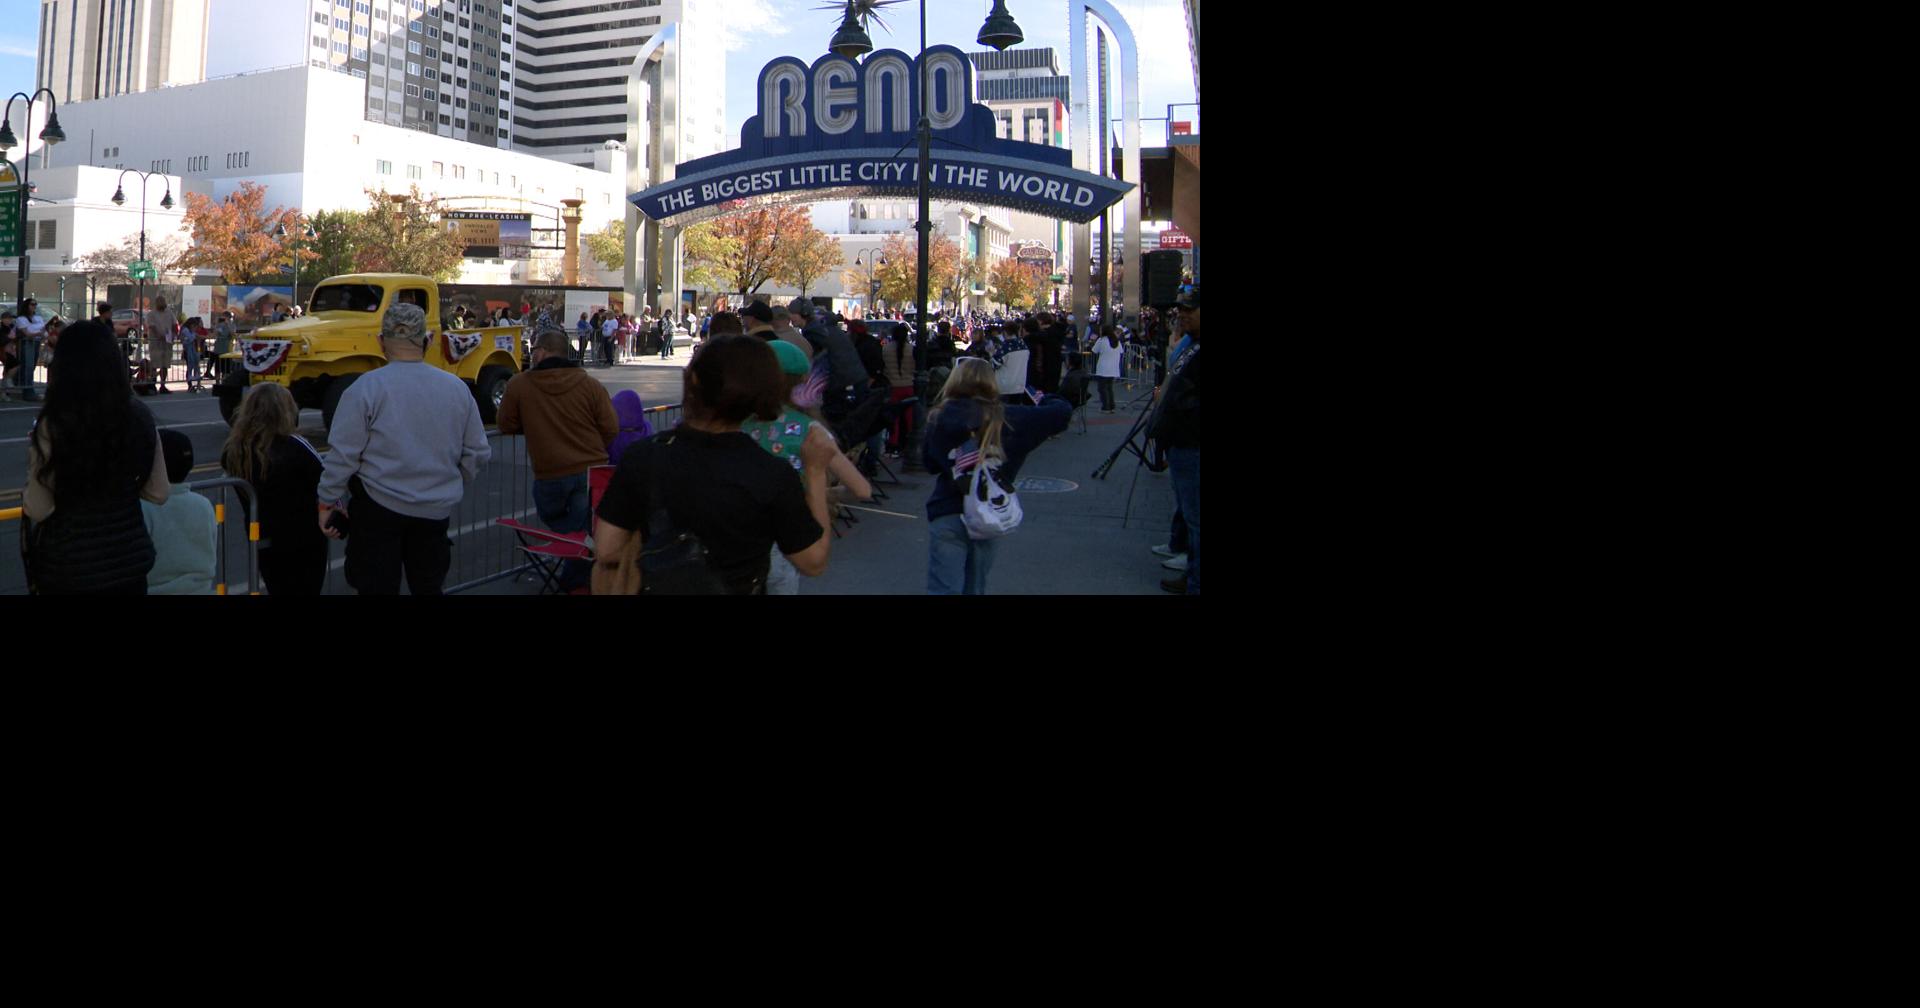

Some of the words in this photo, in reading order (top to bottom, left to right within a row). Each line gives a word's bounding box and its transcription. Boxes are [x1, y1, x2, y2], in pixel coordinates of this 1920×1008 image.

[764, 52, 965, 137] RENO
[658, 188, 695, 213] THE
[701, 170, 783, 201] BIGGEST
[790, 164, 851, 185] LITTLE
[858, 162, 907, 181] CITY
[944, 165, 988, 188] THE
[998, 171, 1094, 207] WORLD
[469, 212, 525, 220] PRE-LEASING
